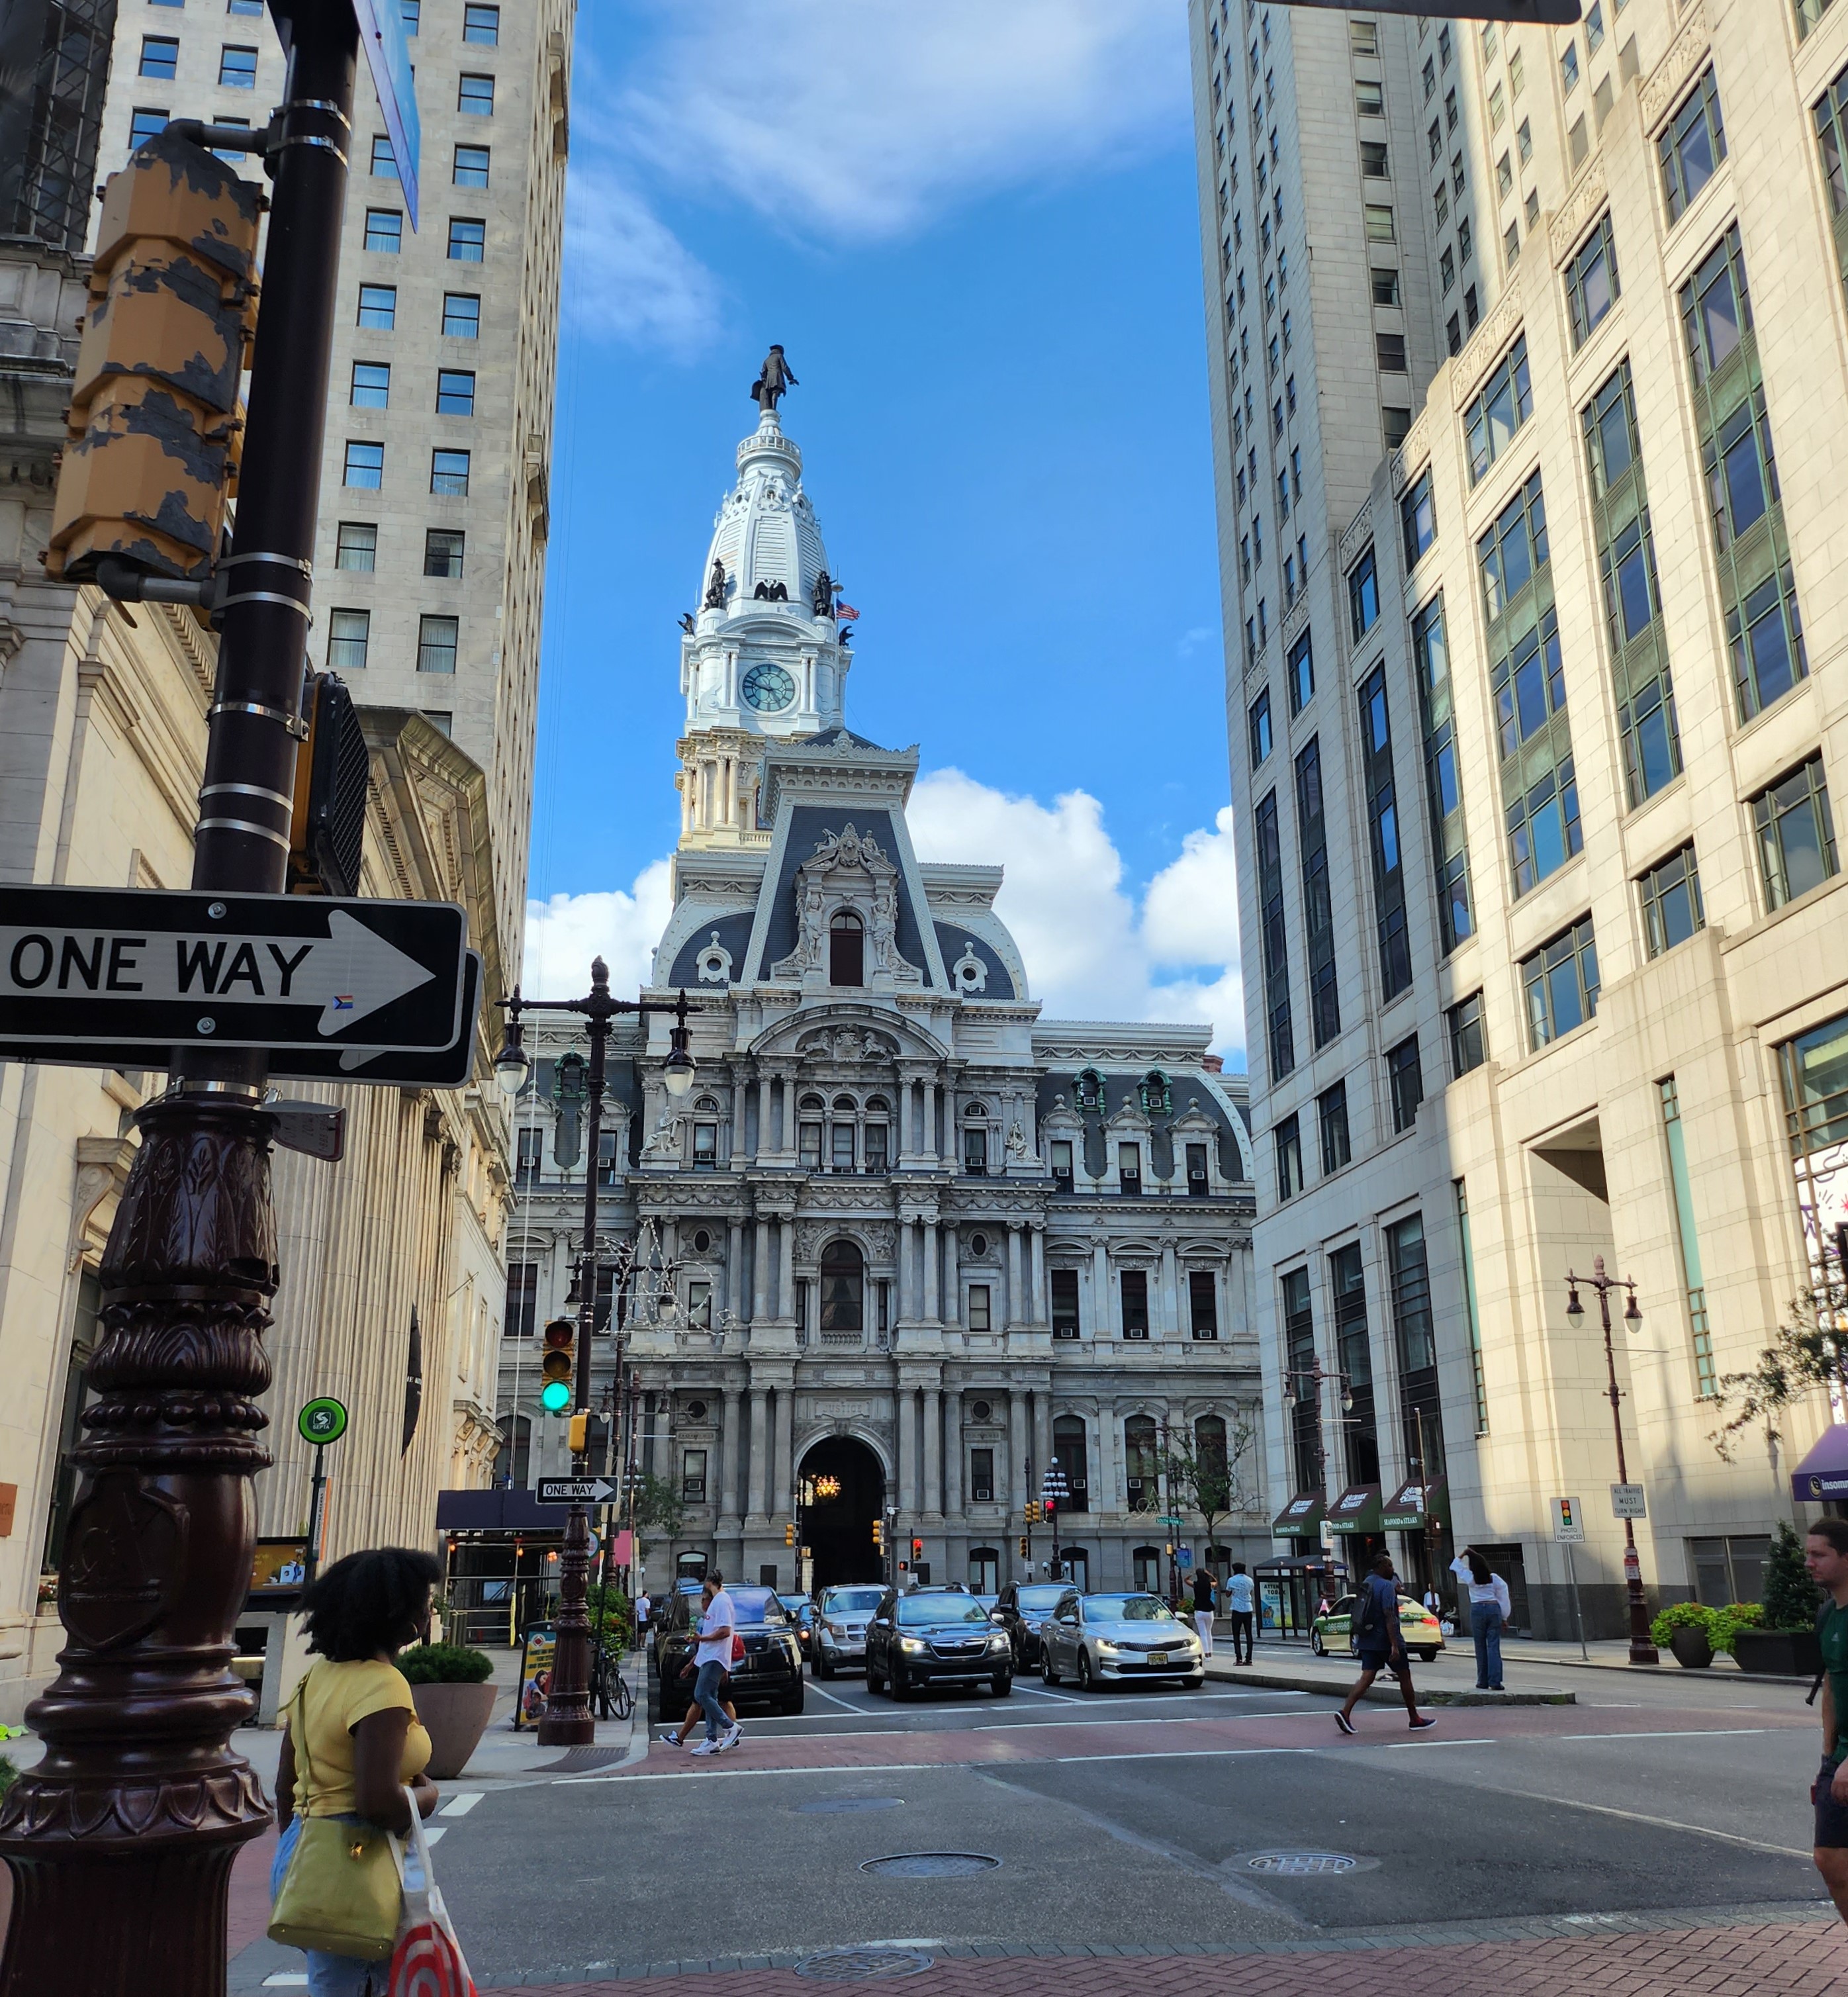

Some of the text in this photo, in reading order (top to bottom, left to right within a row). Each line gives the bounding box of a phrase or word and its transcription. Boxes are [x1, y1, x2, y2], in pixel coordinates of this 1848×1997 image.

[10, 933, 314, 997] ONE WAY
[822, 1404, 862, 1413] JUSTICE
[545, 1485, 594, 1495] ONE WAY
